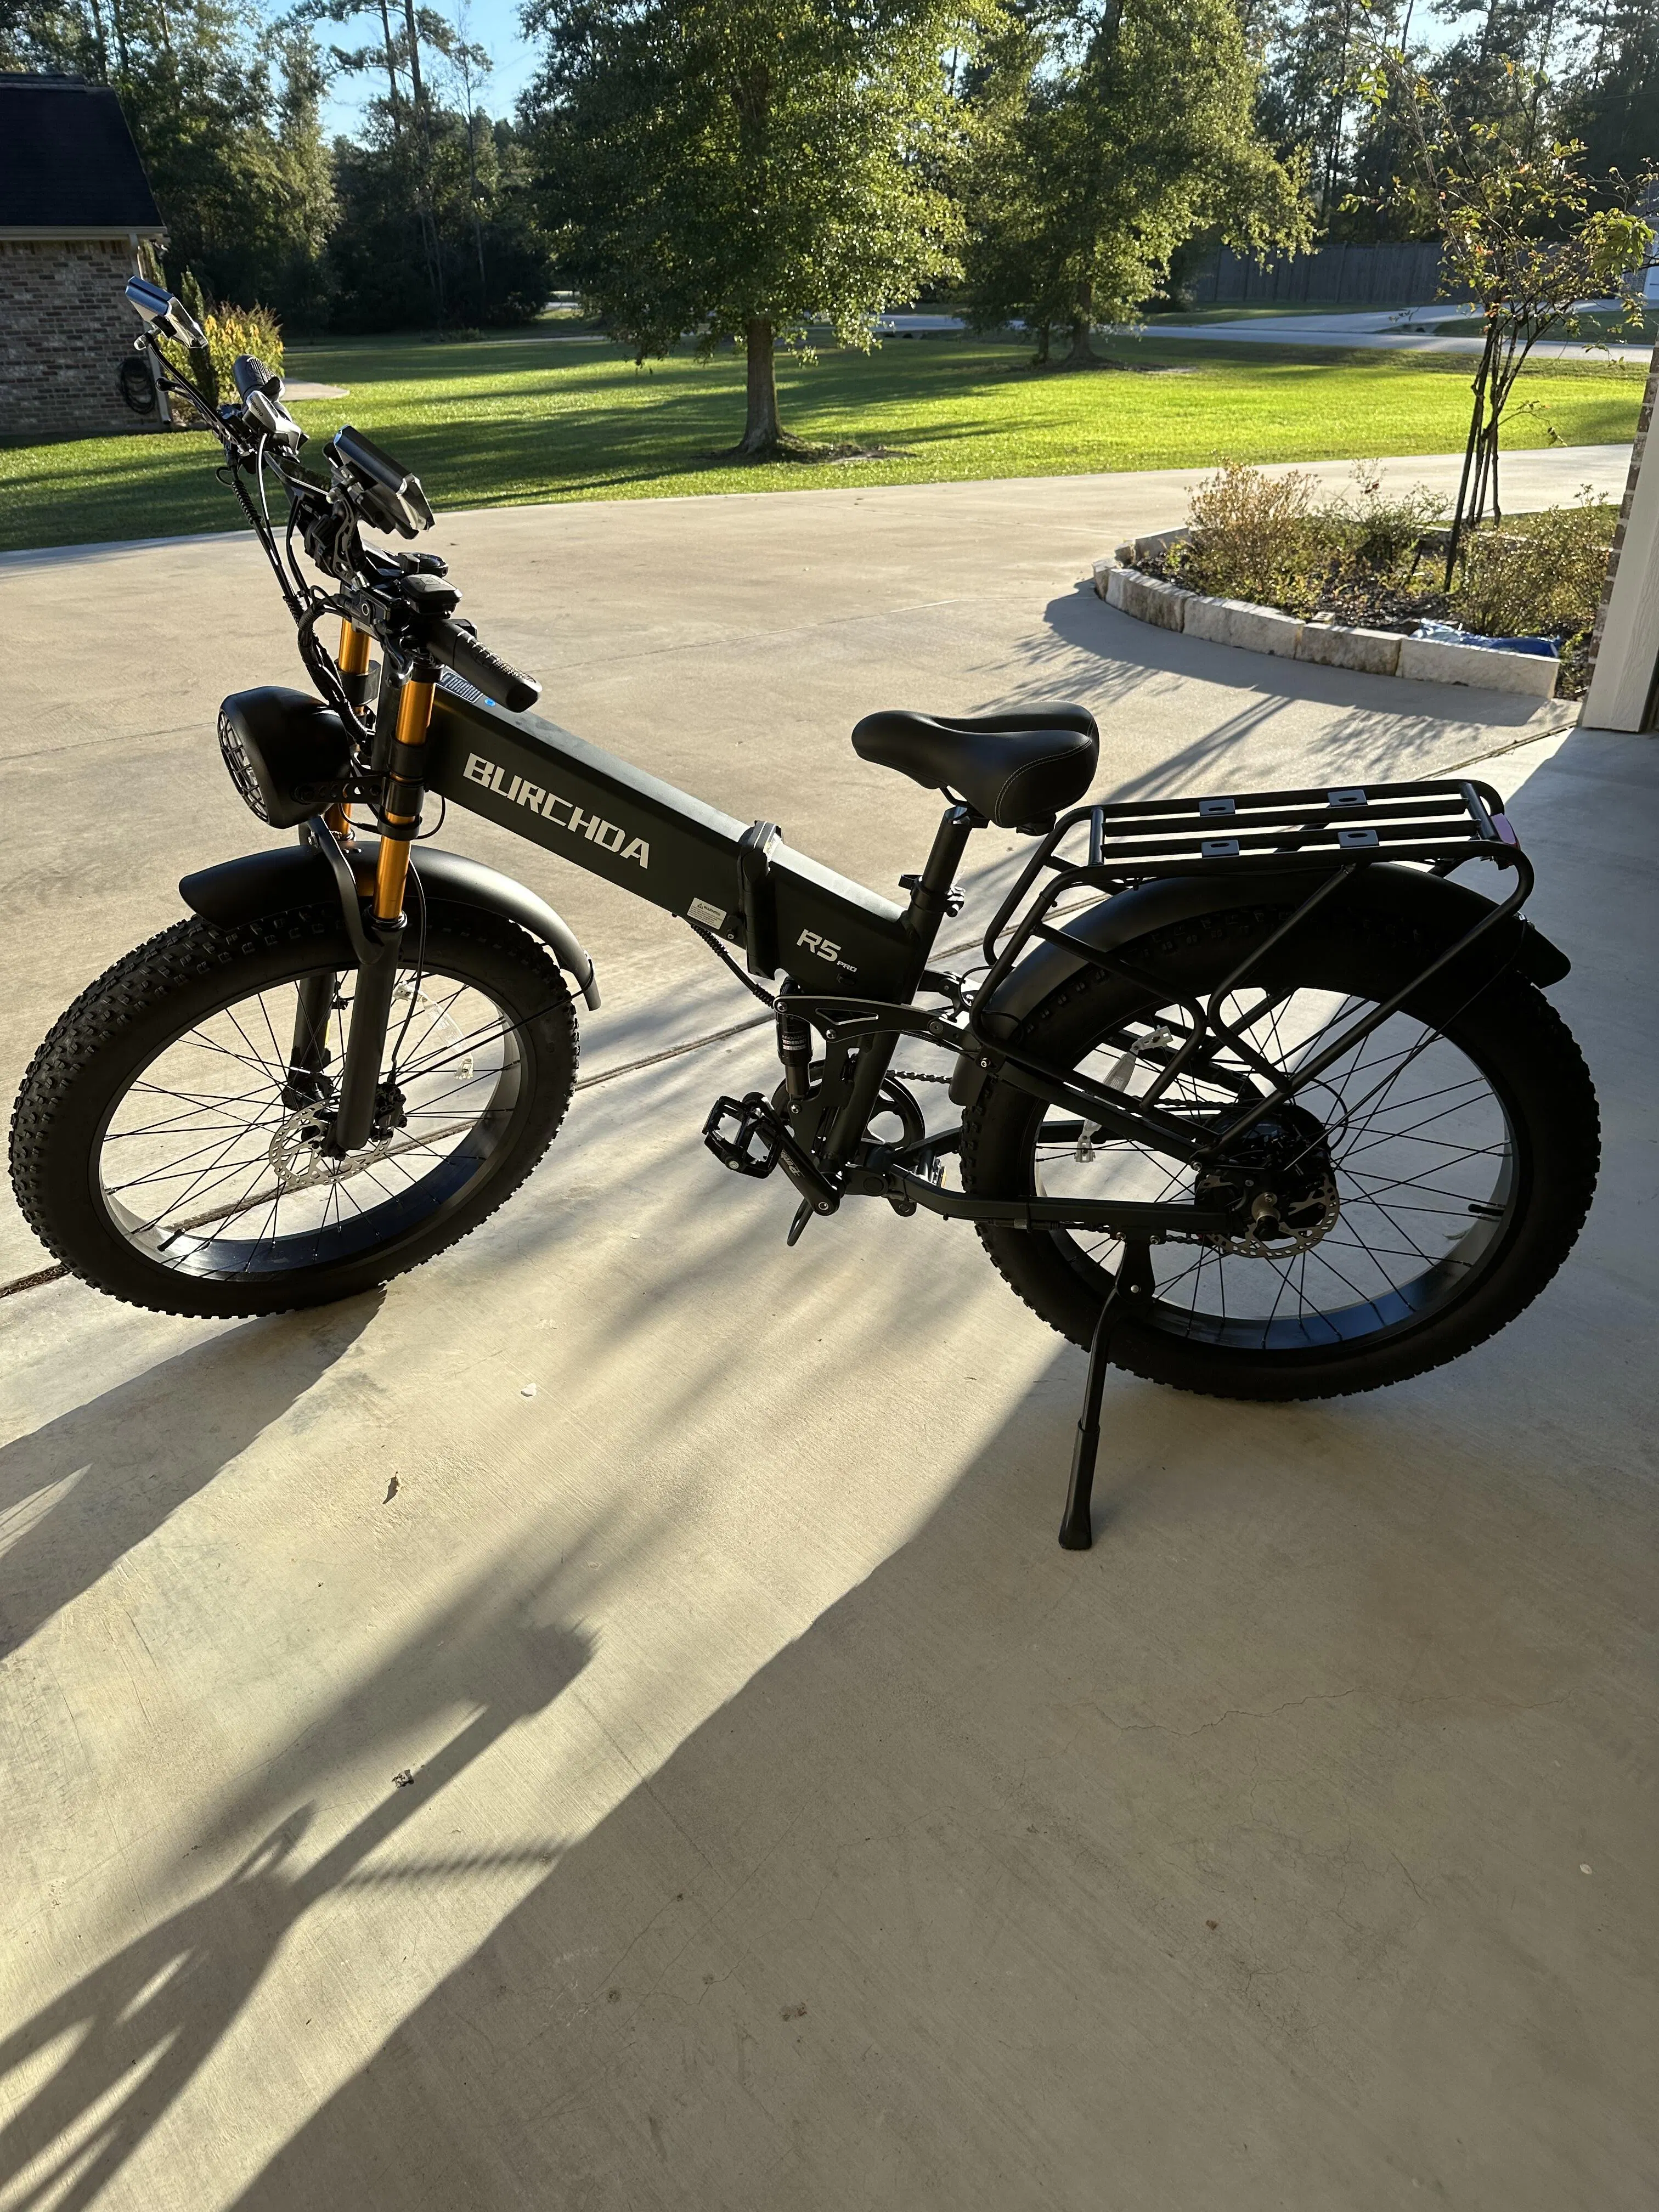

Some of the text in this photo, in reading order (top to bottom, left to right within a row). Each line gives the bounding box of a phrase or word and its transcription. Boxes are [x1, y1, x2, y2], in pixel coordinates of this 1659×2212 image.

[462, 752, 650, 870] BURCHDA
[796, 928, 857, 973] R5 PRO
